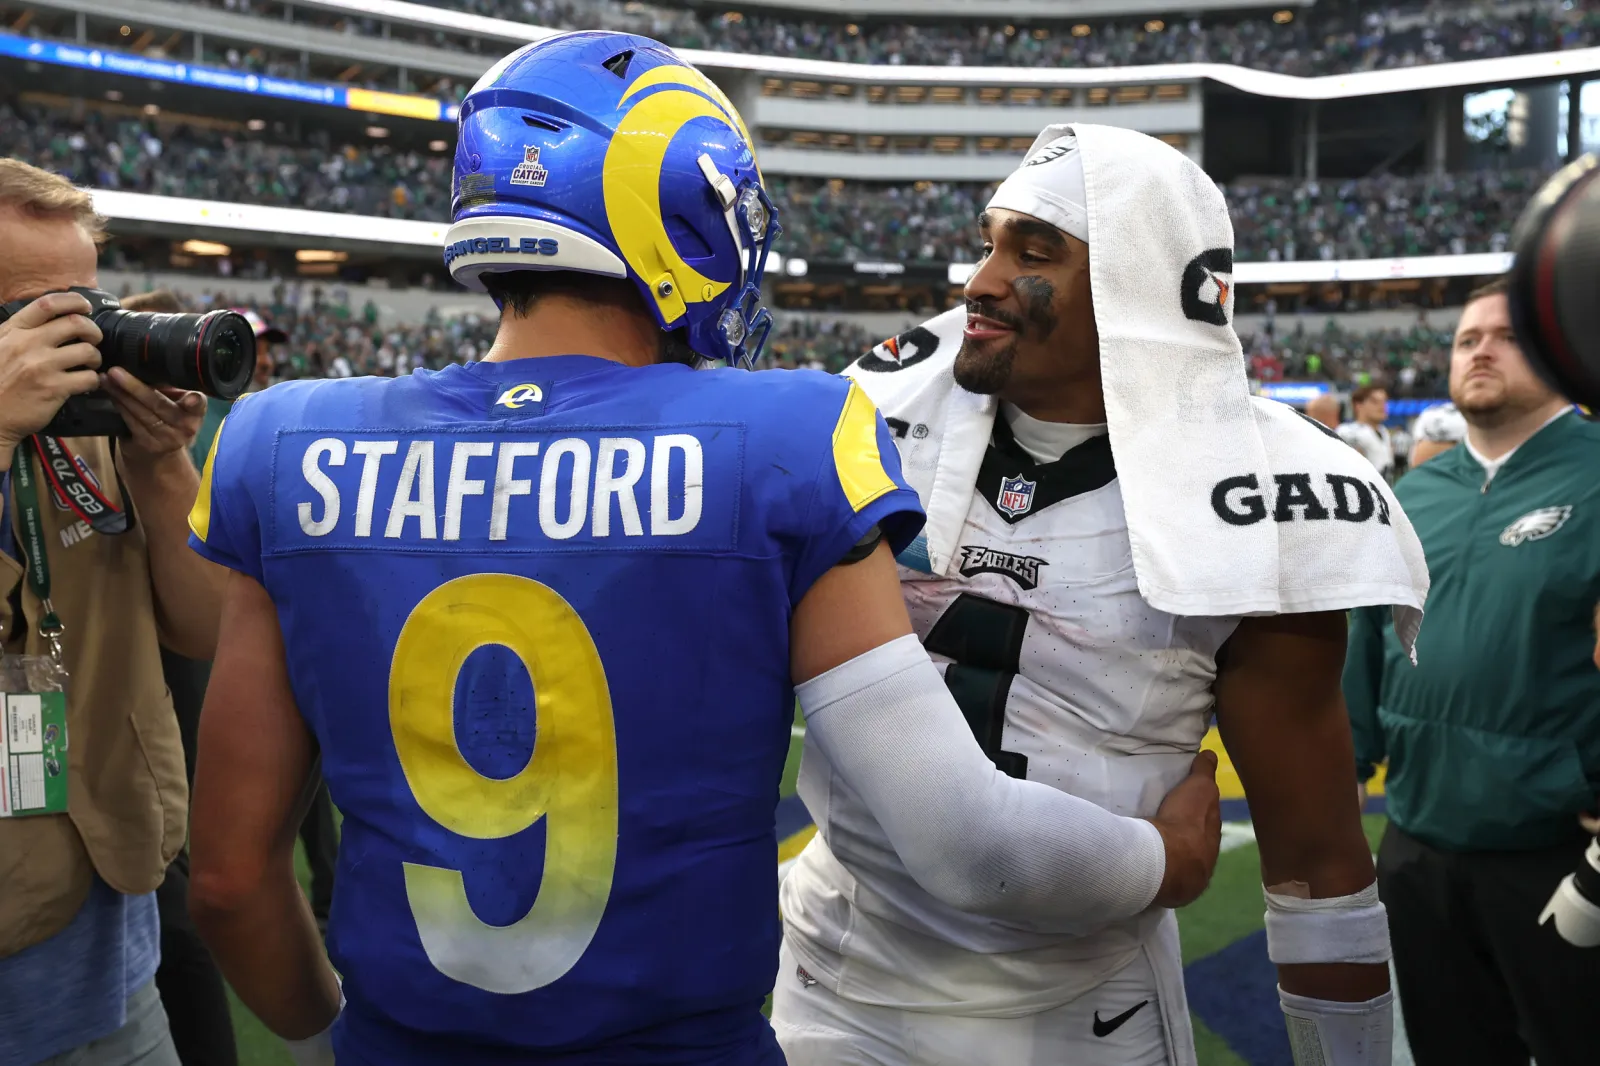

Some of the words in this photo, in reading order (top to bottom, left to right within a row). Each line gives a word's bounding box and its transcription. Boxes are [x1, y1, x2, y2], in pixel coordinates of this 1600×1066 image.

[527, 153, 538, 161] NFL
[513, 169, 547, 181] CATCH
[453, 237, 559, 257] ANGELES
[45, 435, 61, 455] Mar
[52, 459, 76, 481] 7D
[297, 433, 704, 541] STAFFORD
[67, 482, 104, 515] EOS
[1003, 491, 1026, 510] NFL
[26, 507, 34, 520] THE
[960, 546, 1044, 588] EAGLES
[388, 573, 619, 994] 9
